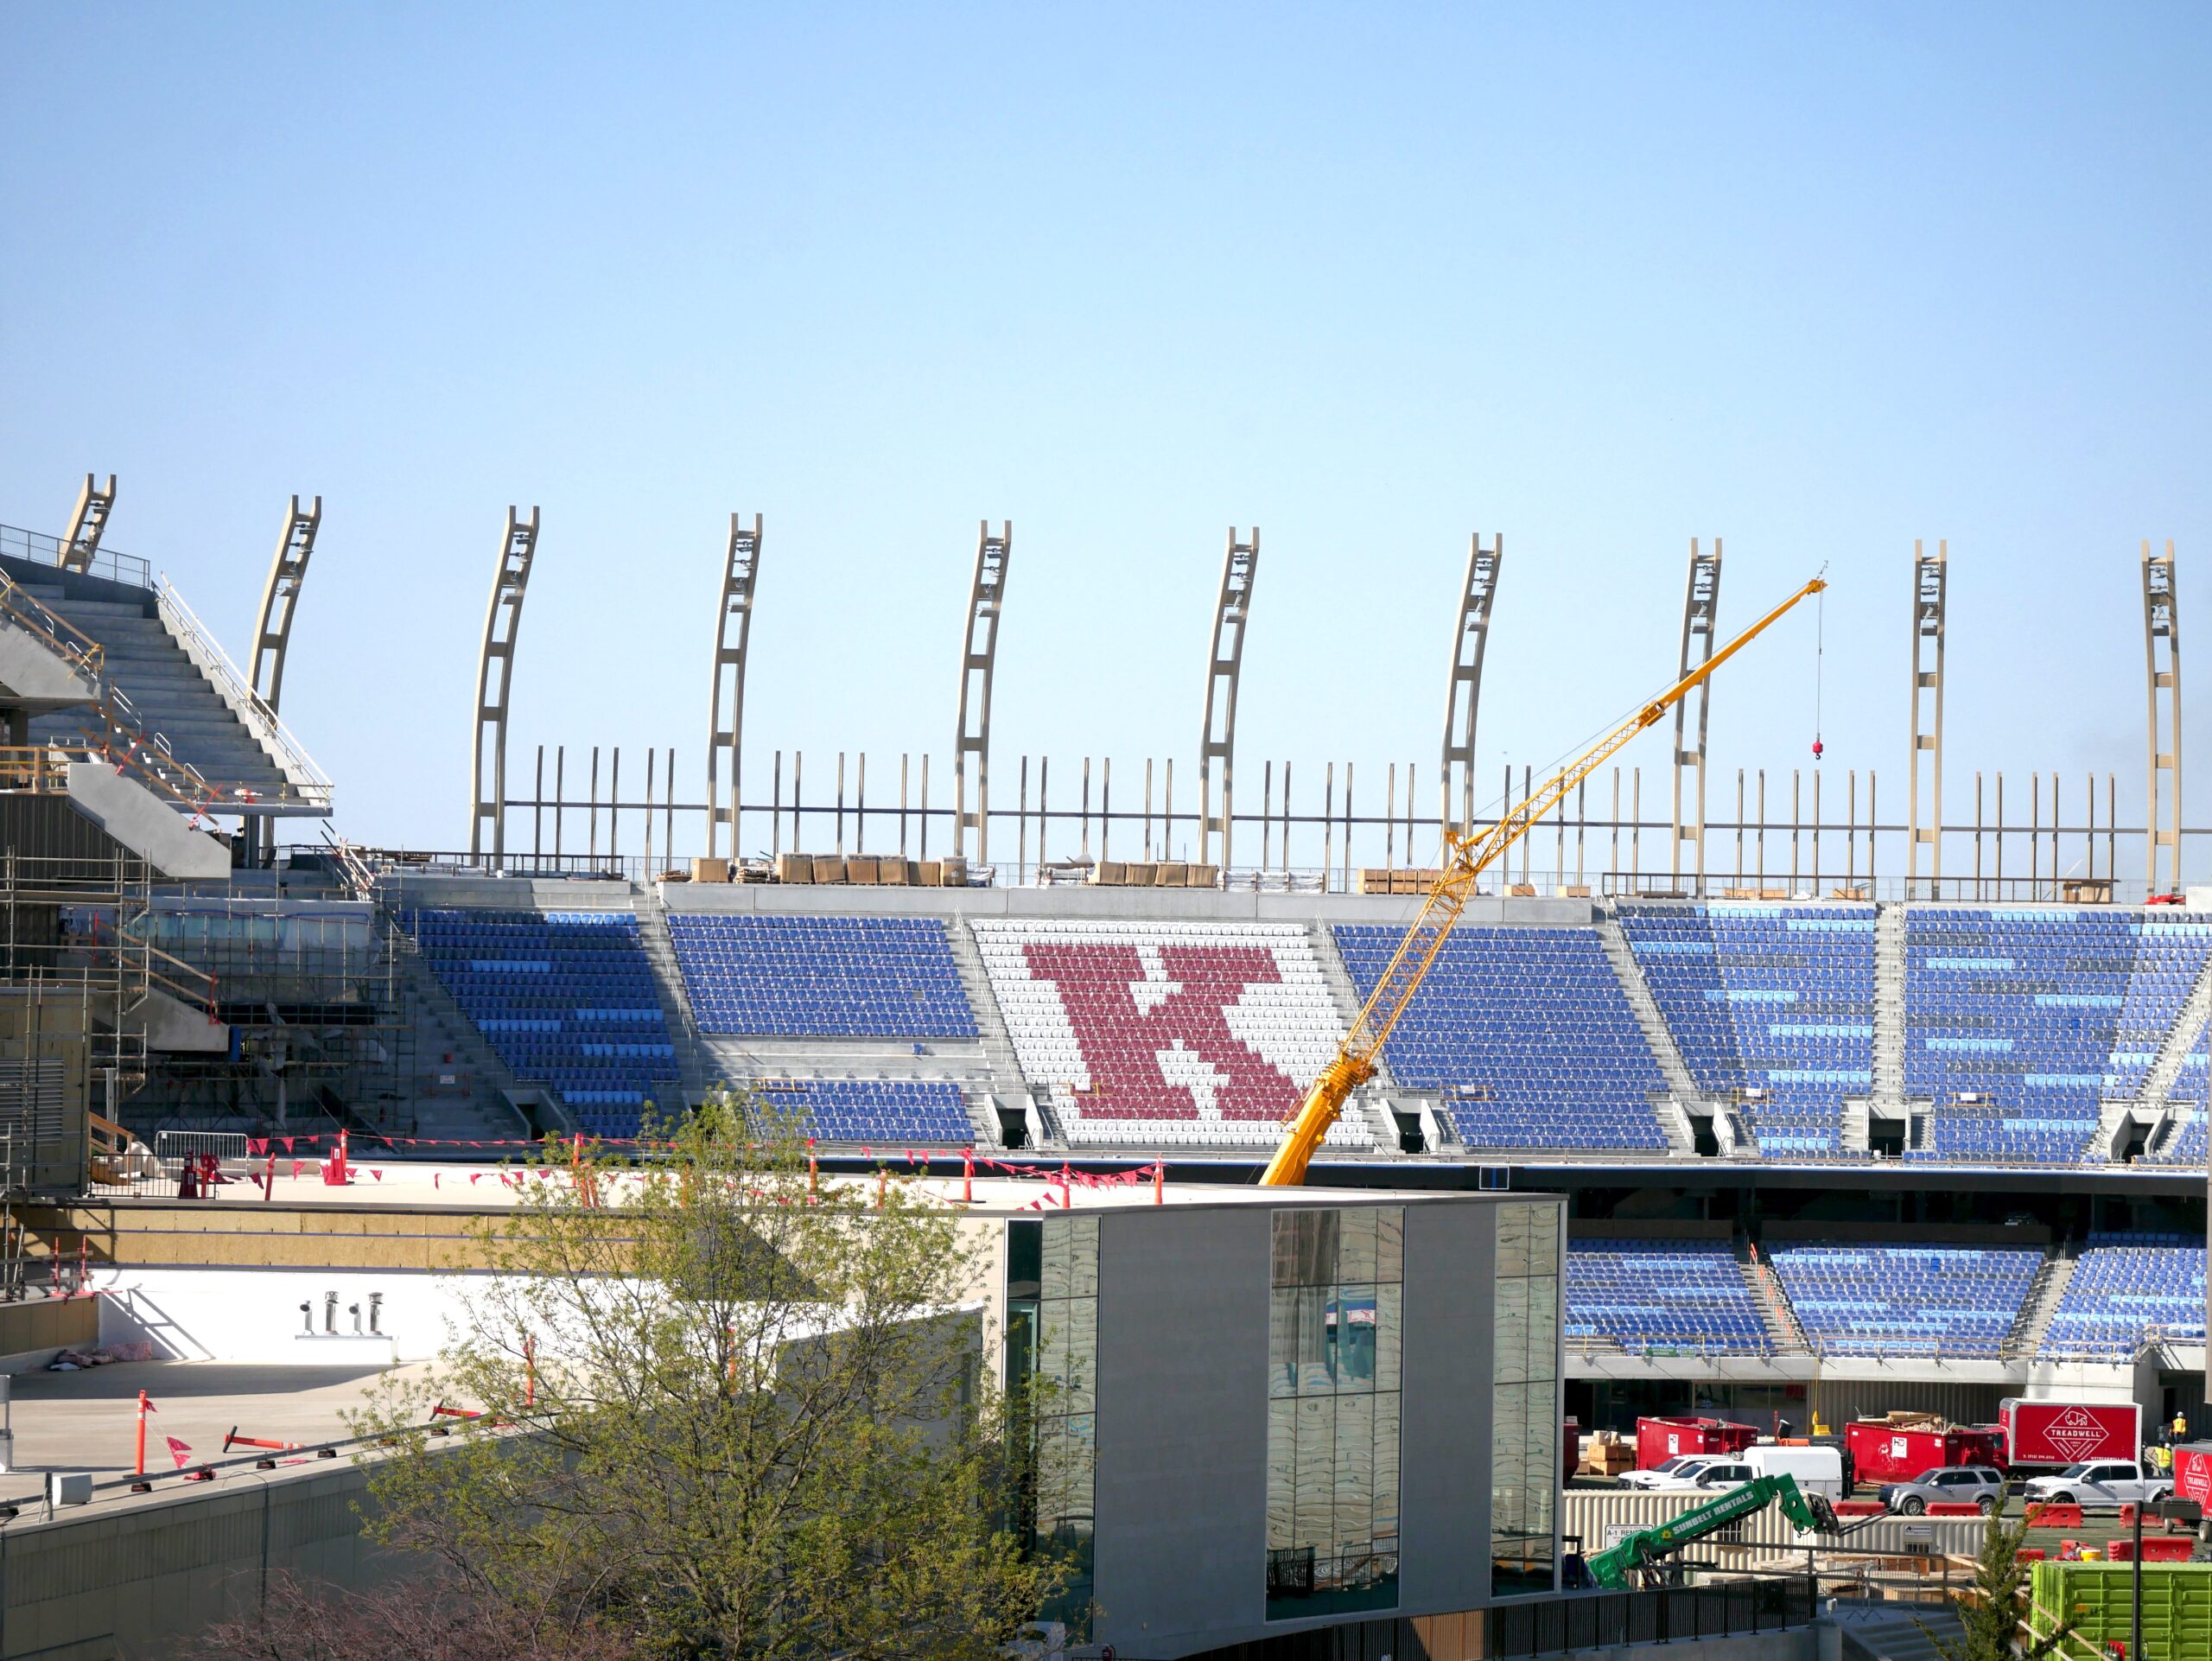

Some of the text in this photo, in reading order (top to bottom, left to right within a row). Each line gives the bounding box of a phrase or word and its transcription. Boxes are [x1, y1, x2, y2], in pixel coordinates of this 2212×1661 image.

[1022, 944, 1341, 1121] K
[1672, 1491, 1754, 1535] SUNBELT RENTALS
